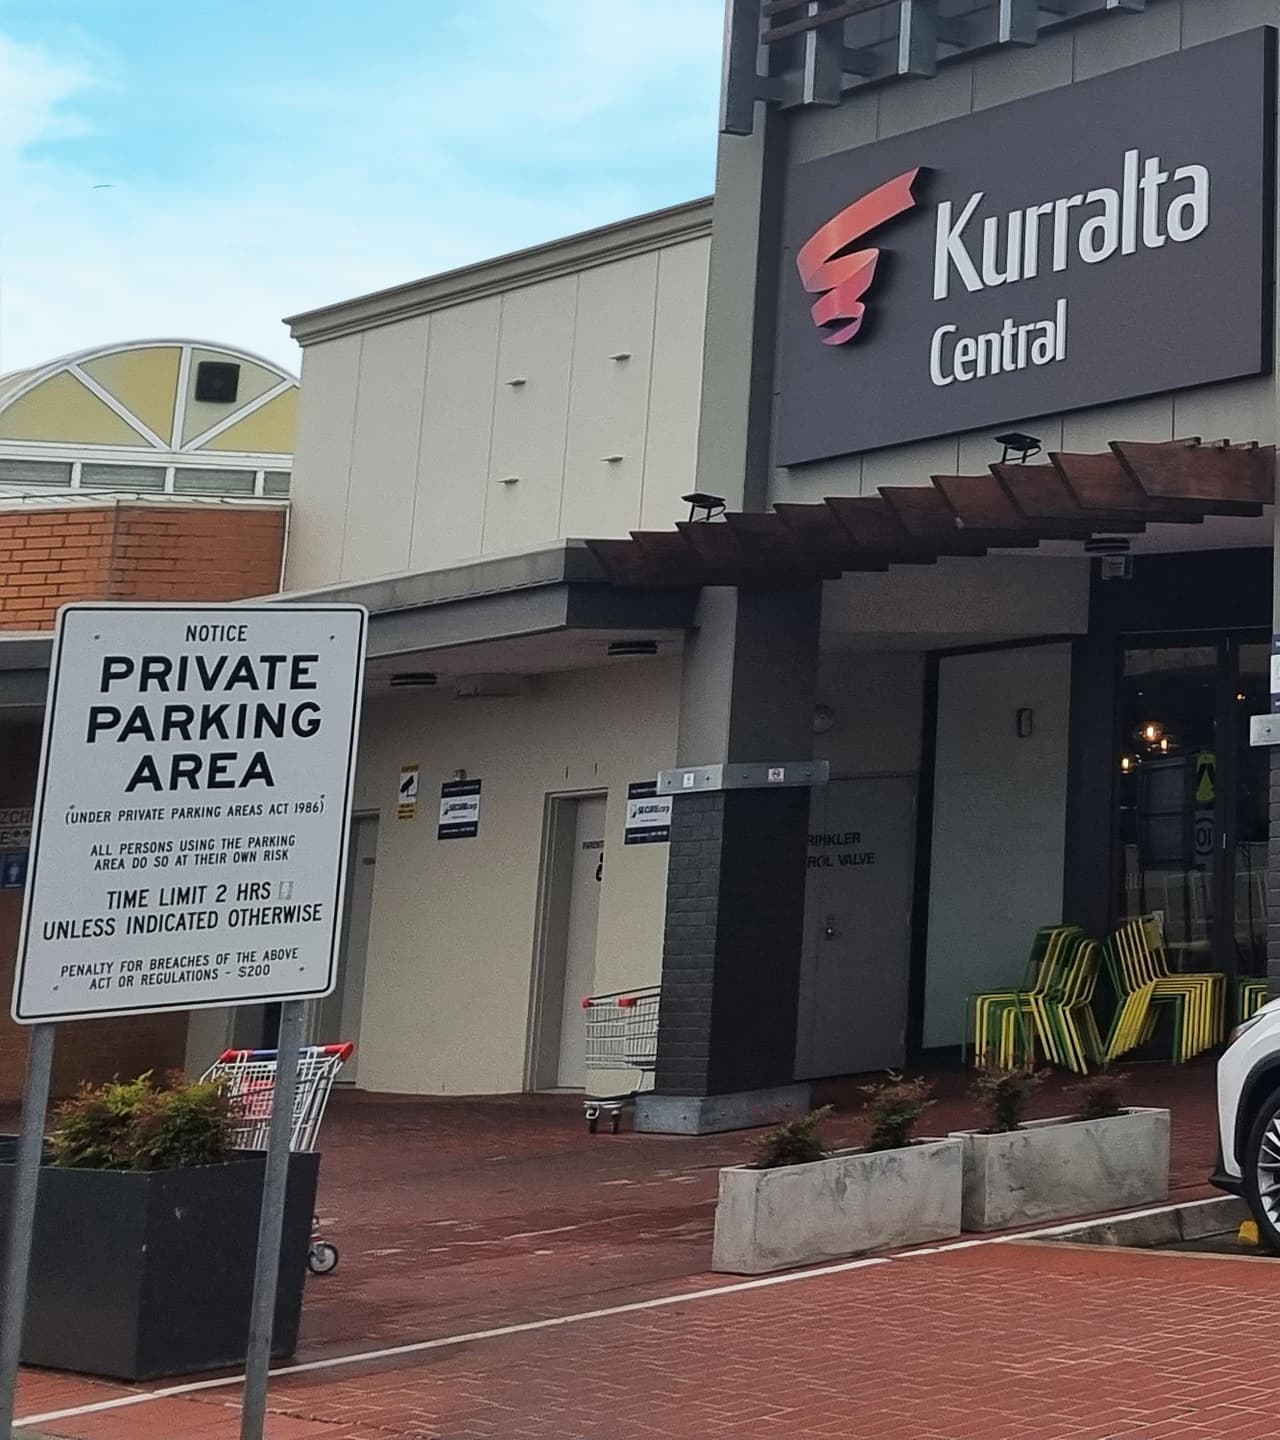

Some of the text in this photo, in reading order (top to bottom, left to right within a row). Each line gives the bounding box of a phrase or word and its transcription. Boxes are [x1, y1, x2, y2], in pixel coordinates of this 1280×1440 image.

[933, 148, 1210, 301] Kurralta
[930, 298, 1068, 387] Central
[185, 624, 248, 642] NOTICE
[100, 654, 319, 693] PRIVATE
[86, 701, 322, 743] PARKING
[125, 751, 274, 792] AREA
[65, 800, 324, 825] (UNDER PRIVATE PARKING AREAS ACT 1986)
[90, 835, 296, 856] ALL PERSONS USING THE PARKING
[94, 849, 288, 871] AREA DO SO AT THEIR OWN RISK
[106, 881, 271, 910] TIME LIMIT 2 HRS
[43, 903, 323, 940] UNLESS INDICATED OTHERWISE
[60, 947, 299, 977] PENALTY FOR BREACHES OF THE ABOVE
[89, 976, 112, 990] ACT
[118, 975, 134, 988] OR
[141, 968, 219, 986] REGULATIONS
